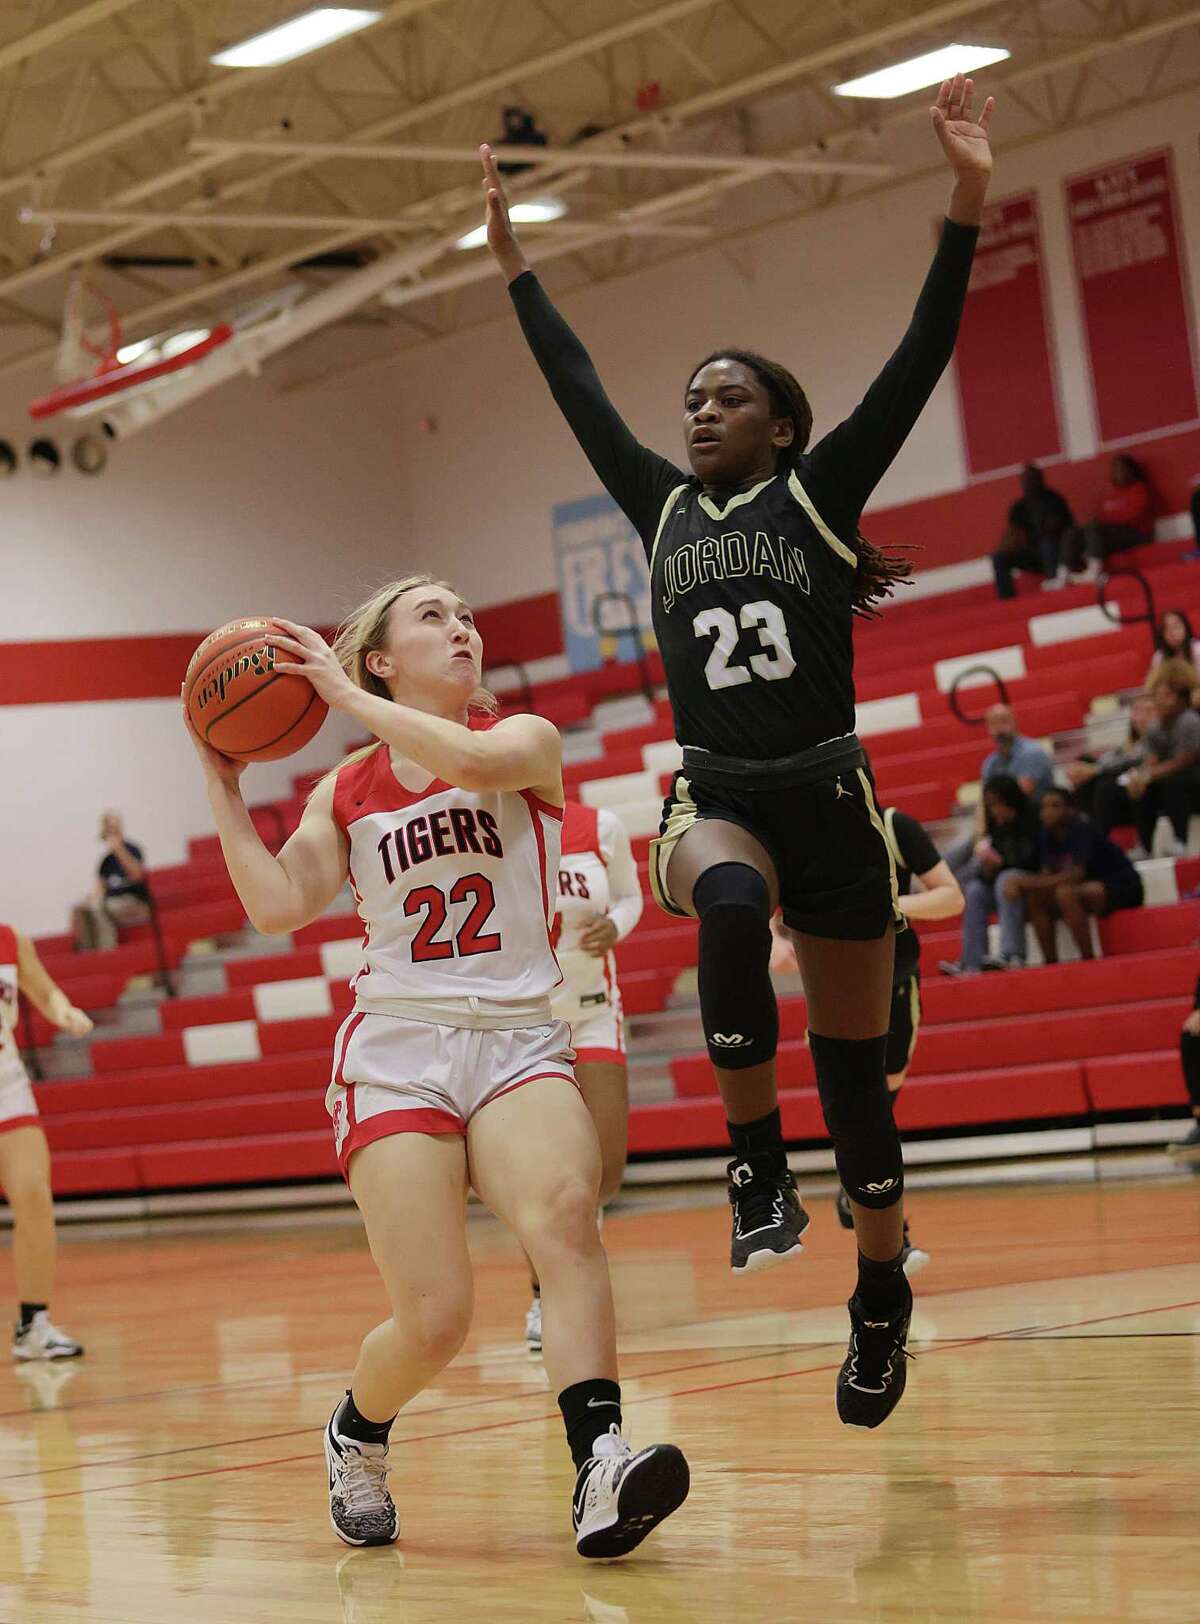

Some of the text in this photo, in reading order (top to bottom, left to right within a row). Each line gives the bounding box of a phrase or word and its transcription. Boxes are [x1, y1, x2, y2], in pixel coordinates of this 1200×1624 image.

[663, 531, 810, 613] JORDAN
[198, 645, 275, 709] Baden
[692, 600, 797, 690] 23
[377, 808, 503, 884] TIGERS
[403, 873, 502, 962] 22
